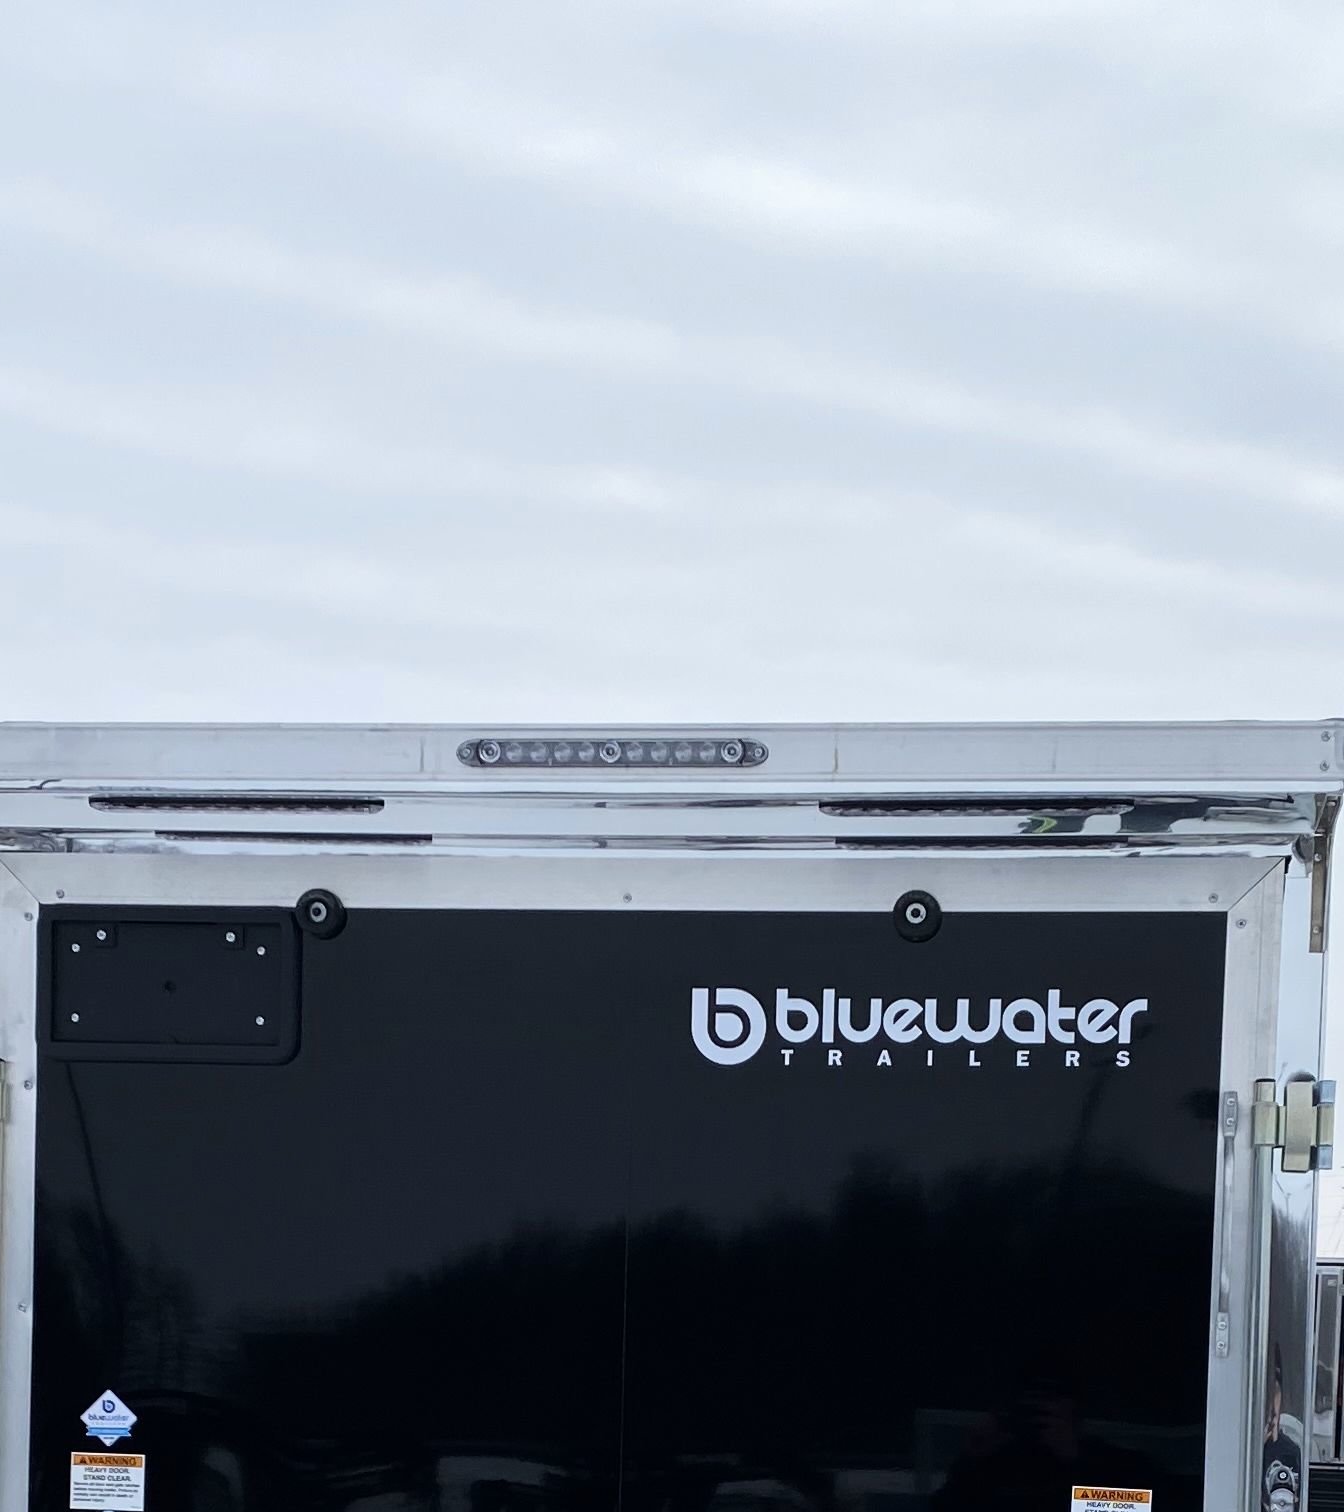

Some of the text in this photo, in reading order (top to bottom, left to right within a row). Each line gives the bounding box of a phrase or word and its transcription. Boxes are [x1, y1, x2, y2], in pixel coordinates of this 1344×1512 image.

[776, 988, 1148, 1044] bluewater
[780, 1049, 1131, 1068] TRAILERS
[87, 1456, 137, 1466] WARNING
[1091, 1490, 1143, 1501] WARNING
